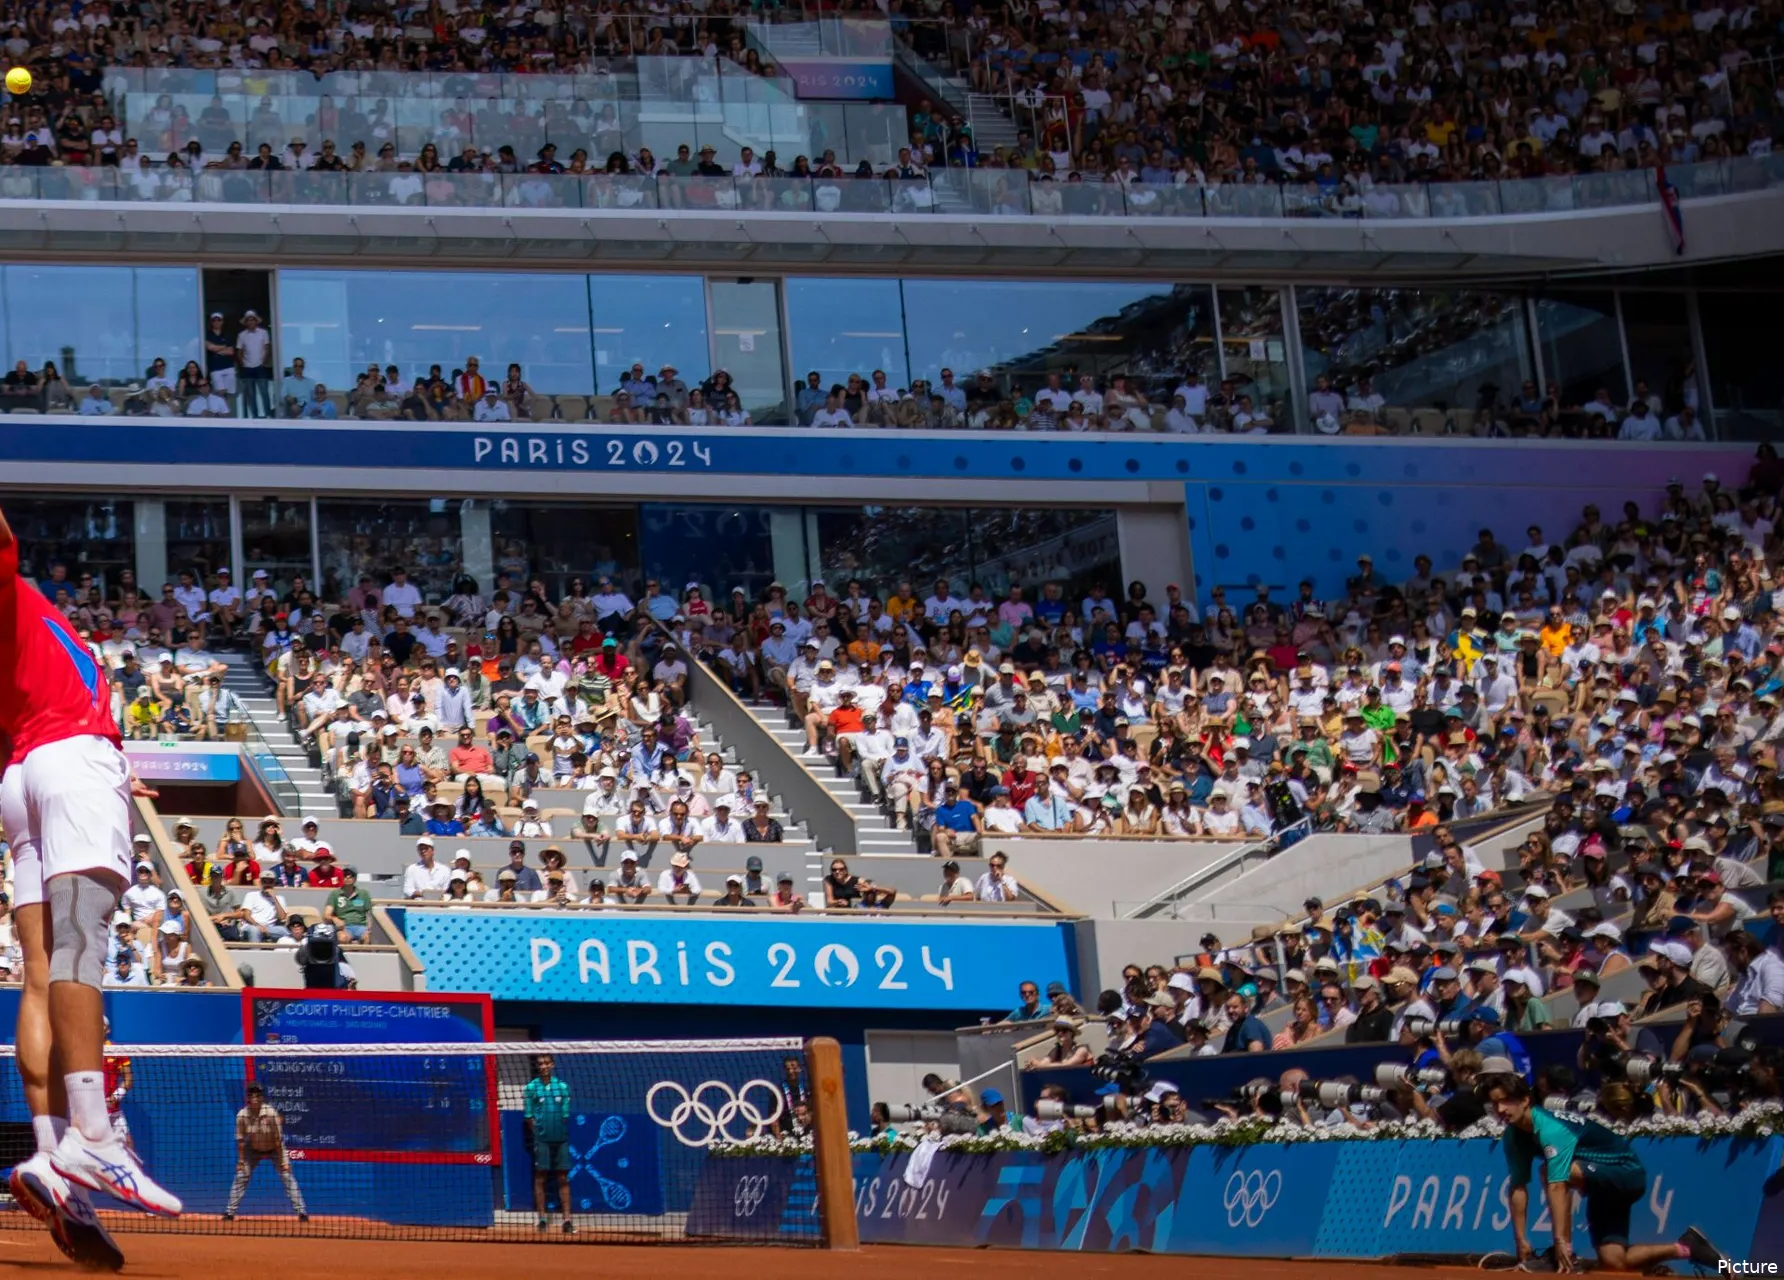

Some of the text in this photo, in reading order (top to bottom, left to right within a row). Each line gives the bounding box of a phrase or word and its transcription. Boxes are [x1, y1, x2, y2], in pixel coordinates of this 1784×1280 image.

[833, 75, 877, 88] 2024
[606, 440, 711, 467] 2024
[173, 761, 208, 772] 2024
[767, 942, 954, 991] 2024
[285, 1003, 450, 1019] COURT PHILIPPE-CHATRIER
